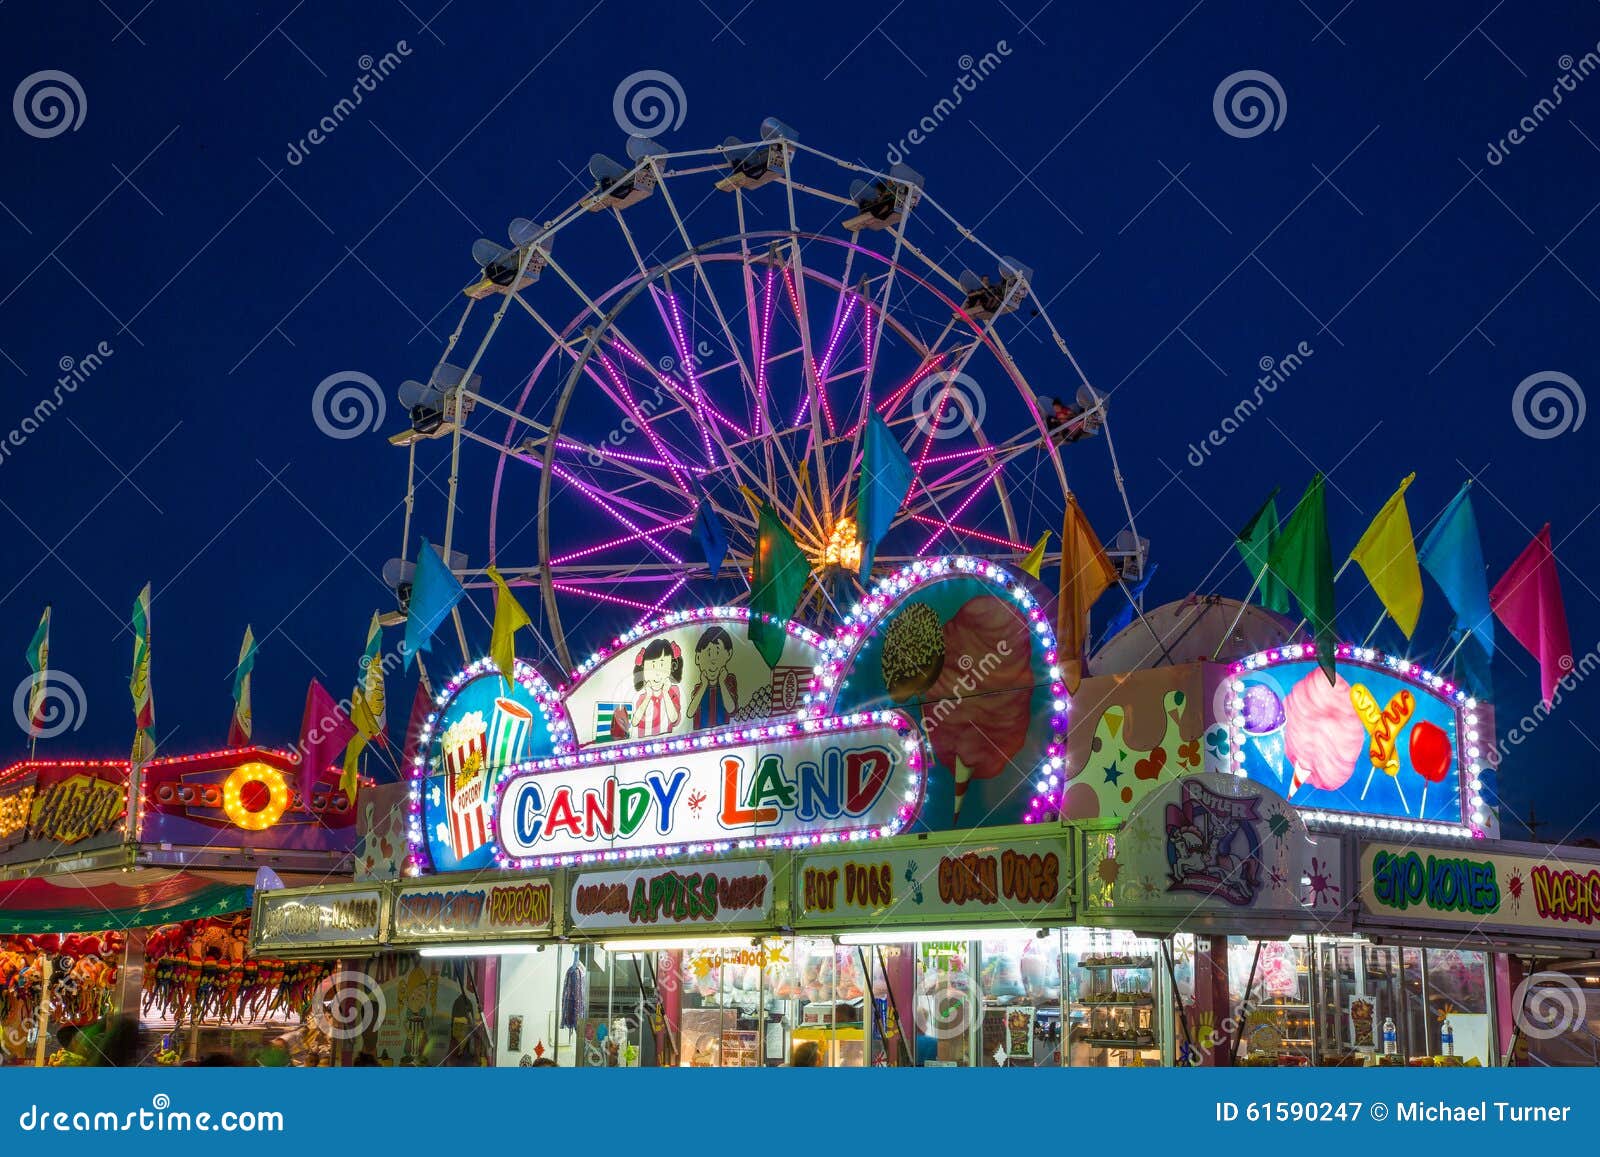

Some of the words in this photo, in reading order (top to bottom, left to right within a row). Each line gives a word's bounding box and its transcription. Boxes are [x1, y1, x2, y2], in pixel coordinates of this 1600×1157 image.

[458, 781, 482, 809] POPCORN
[515, 768, 690, 848] CANDY
[716, 745, 896, 828] LAND
[1190, 783, 1250, 819] BUTLER
[628, 870, 719, 923] APPLES
[804, 866, 838, 913] HOT
[845, 860, 894, 907] DOGS
[938, 852, 998, 905] CORN
[1001, 849, 1059, 903] DOGS
[1373, 850, 1424, 909] SNO
[1426, 854, 1500, 914] KONES
[490, 882, 551, 927] POPCORN
